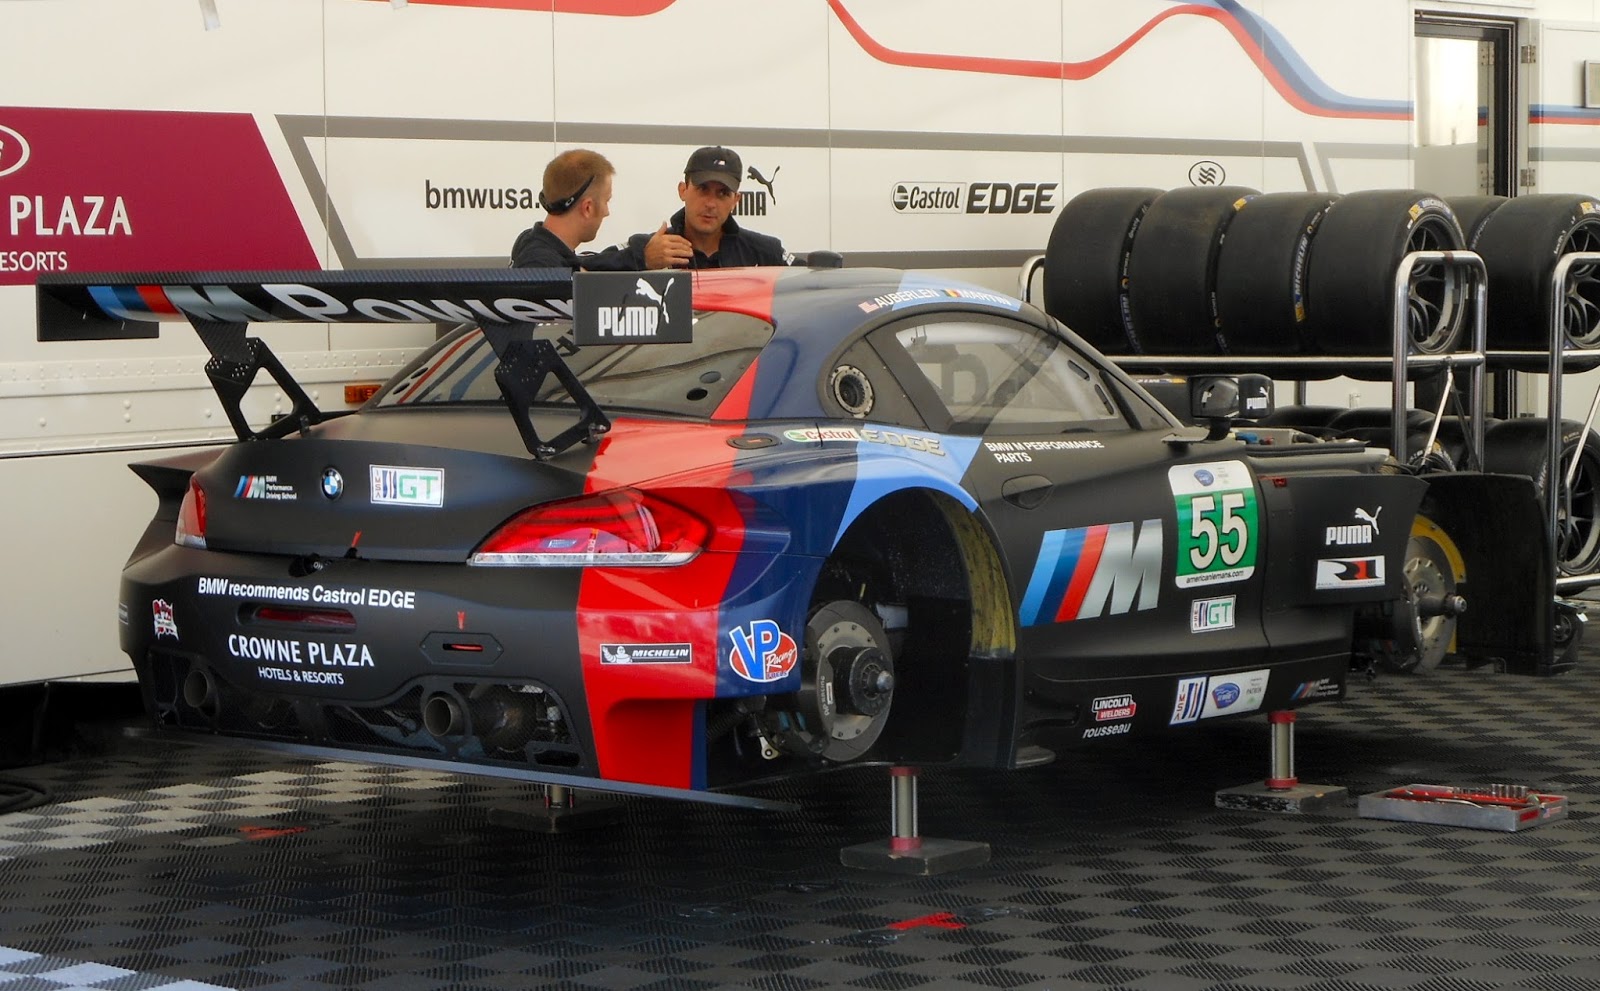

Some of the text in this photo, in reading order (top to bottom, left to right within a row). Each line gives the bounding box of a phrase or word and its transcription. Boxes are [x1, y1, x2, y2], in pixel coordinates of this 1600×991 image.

[909, 182, 1058, 214] Castrol EDGE
[9, 195, 132, 236] PLAZA
[1295, 234, 1308, 295] MICHELIN
[875, 288, 1012, 308] AUBERLEN MARTIN
[598, 306, 658, 336] PUMA
[805, 429, 946, 456] Castrol EDGE
[984, 440, 1105, 452] BMW M PERFORMANCE
[994, 452, 1032, 463] PARTS
[399, 474, 439, 499] GT
[1189, 492, 1249, 571] 55
[1325, 525, 1372, 545] PUMA
[198, 577, 416, 609] BMW recommends Castrol EDGE
[1209, 602, 1232, 624] GT
[228, 634, 375, 667] CROWNE PLAZA
[631, 648, 689, 657] MICHELIN
[729, 620, 780, 681] VP
[258, 666, 345, 685] HOTELS & RESORTS
[1094, 697, 1130, 710] LINCOLN
[1100, 708, 1131, 718] WELDERS
[1174, 684, 1185, 721] IMSA
[1082, 723, 1132, 739] rousseau
